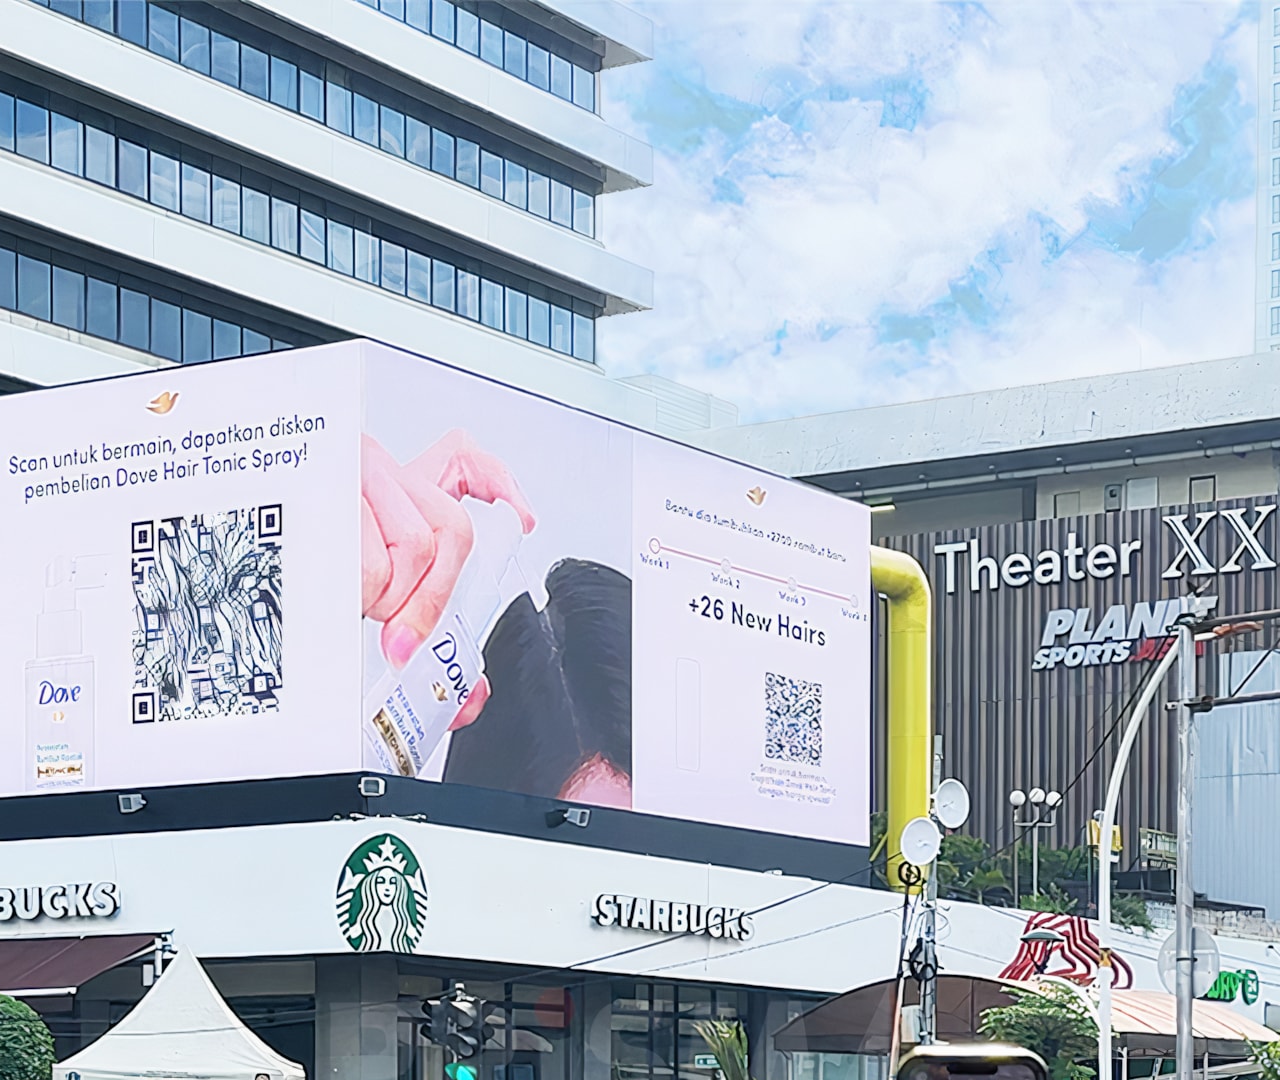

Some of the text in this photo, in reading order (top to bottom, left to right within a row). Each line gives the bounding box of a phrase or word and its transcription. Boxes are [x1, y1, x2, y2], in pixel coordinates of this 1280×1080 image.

[9, 414, 325, 475] Scan untuk bermain, dapatkan diskon
[24, 442, 308, 503] pembelian Dove Hair Tonic Spray!
[933, 532, 1142, 595] Theater
[688, 594, 827, 648] +26 New Hairs
[431, 631, 470, 706] Dove
[1031, 640, 1132, 671] SPORTS
[38, 680, 81, 705] Dove
[590, 893, 756, 942] STARBUCKS
